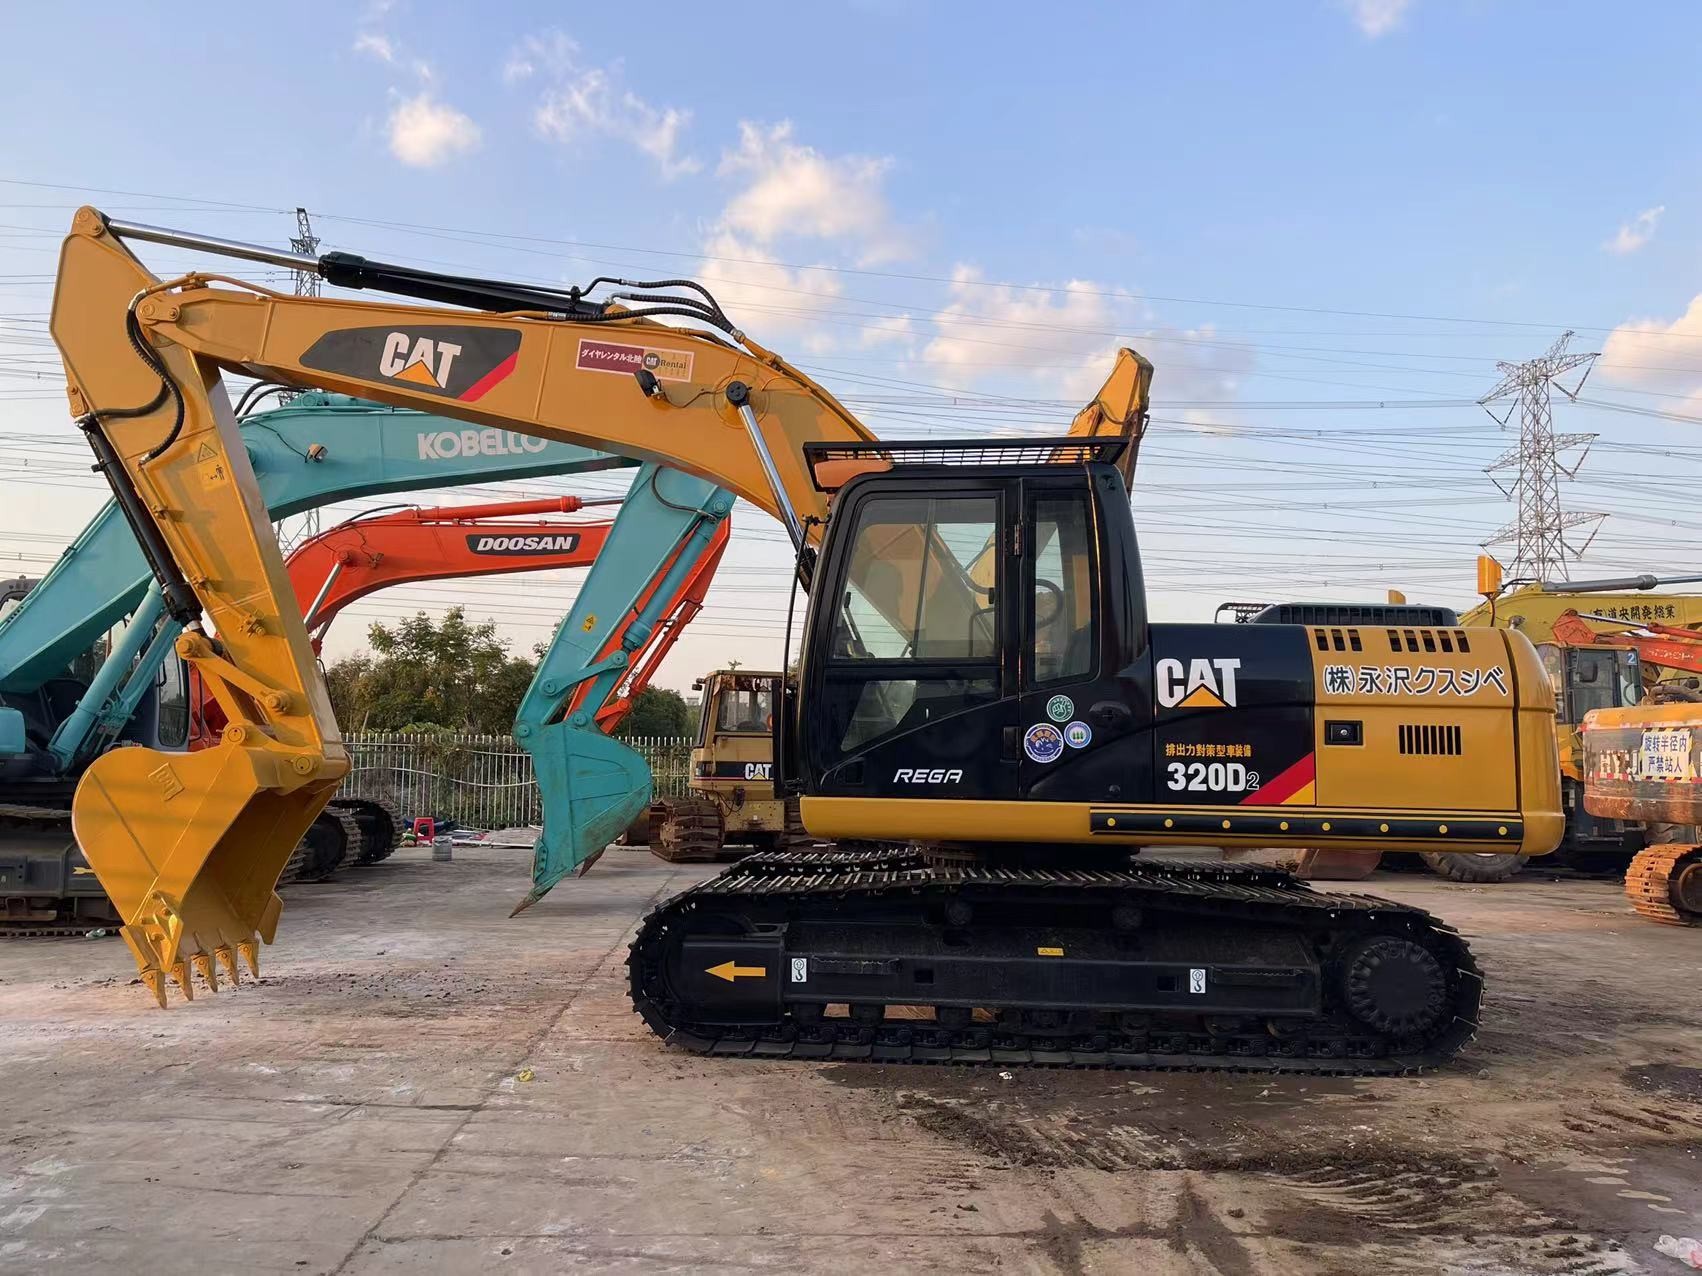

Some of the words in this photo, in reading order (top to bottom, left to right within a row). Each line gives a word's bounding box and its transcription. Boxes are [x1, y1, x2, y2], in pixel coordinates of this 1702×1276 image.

[379, 331, 463, 389] CAT
[660, 359, 687, 370] Rental
[417, 429, 549, 460] KOBELCO
[477, 536, 573, 551] DOOSAN
[1627, 652, 1636, 664] 2
[1156, 658, 1241, 708] CAT
[1643, 735, 1687, 753] 旋转半径内
[744, 763, 772, 780] CAT
[1648, 756, 1682, 773] 严禁站人
[893, 768, 963, 784] REGA
